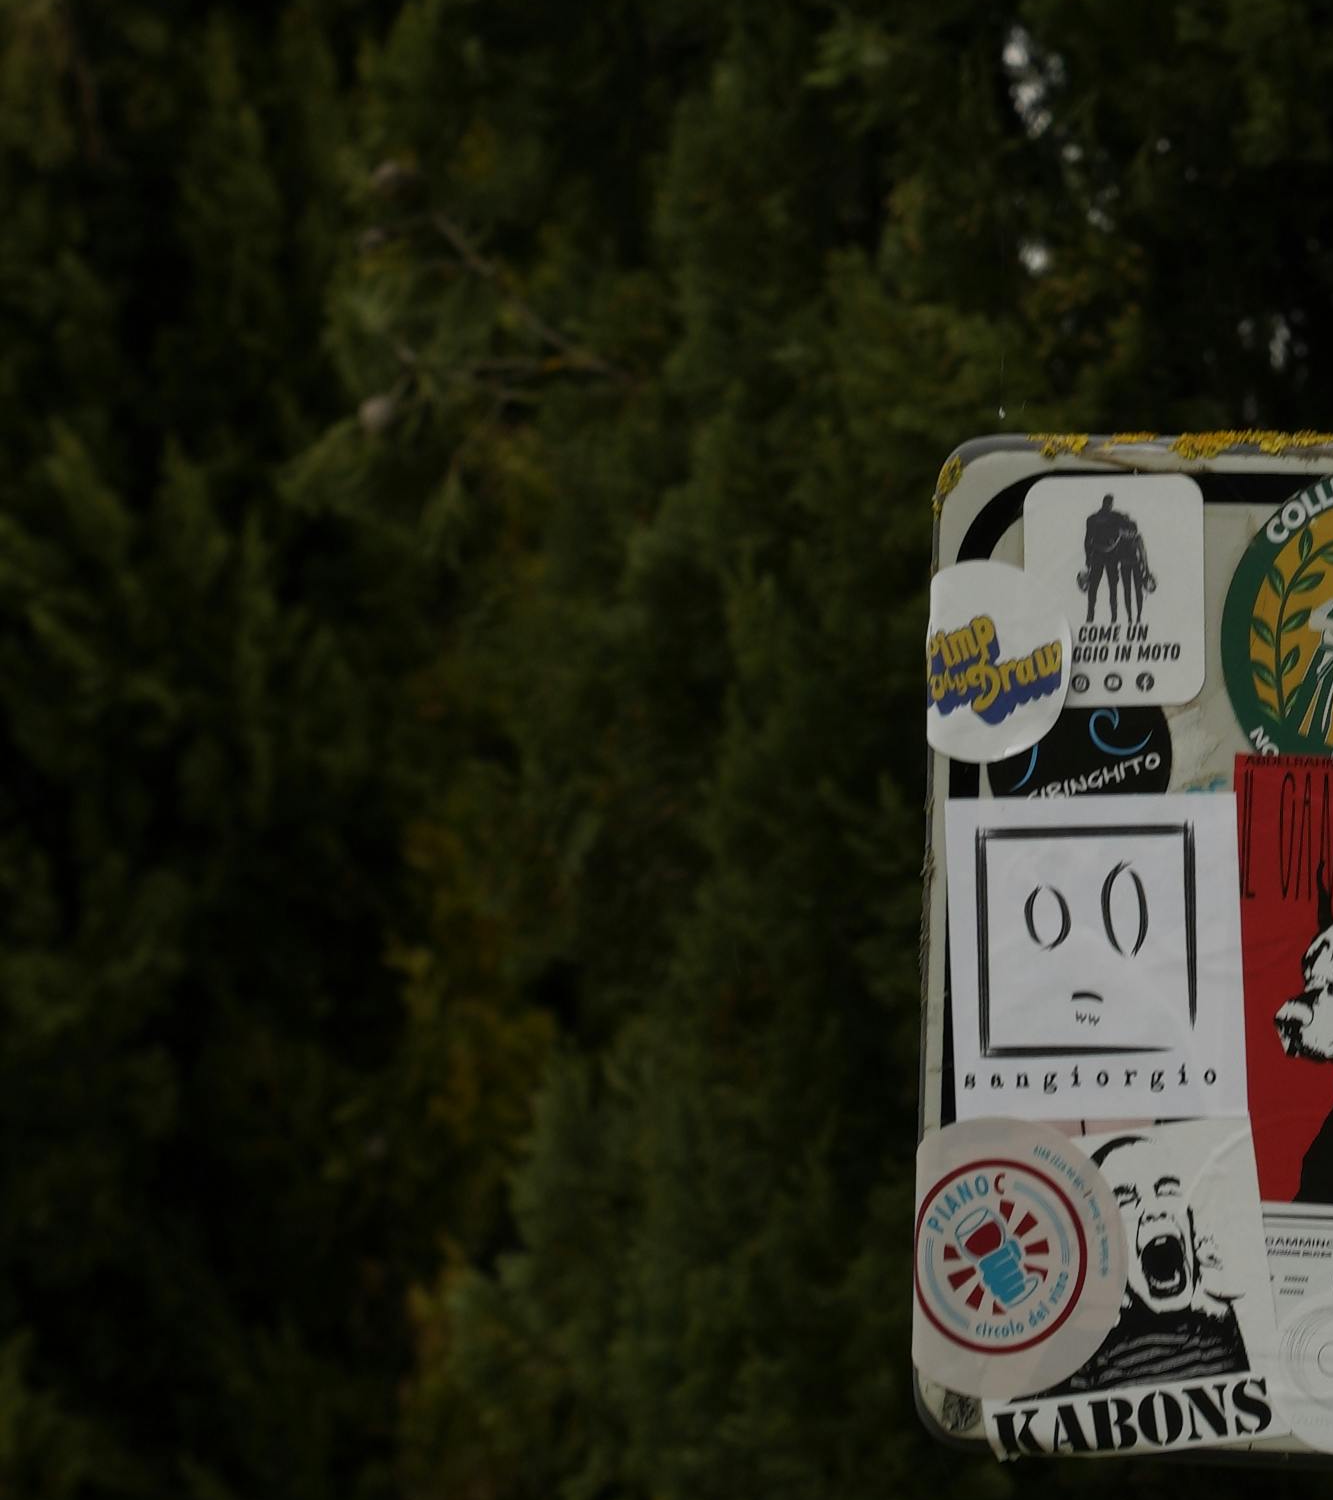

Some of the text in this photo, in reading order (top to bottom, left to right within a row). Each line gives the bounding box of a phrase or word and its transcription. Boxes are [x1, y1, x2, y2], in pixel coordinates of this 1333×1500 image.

[1078, 625, 1149, 644] COME UN
[1114, 644, 1181, 663] IN MOTO
[966, 640, 1063, 713] Draw
[964, 1064, 1218, 1091] sangiorgio
[926, 1175, 988, 1235] PIANO
[974, 1304, 1051, 1338] circolo del
[992, 1375, 1273, 1462] KABONS
